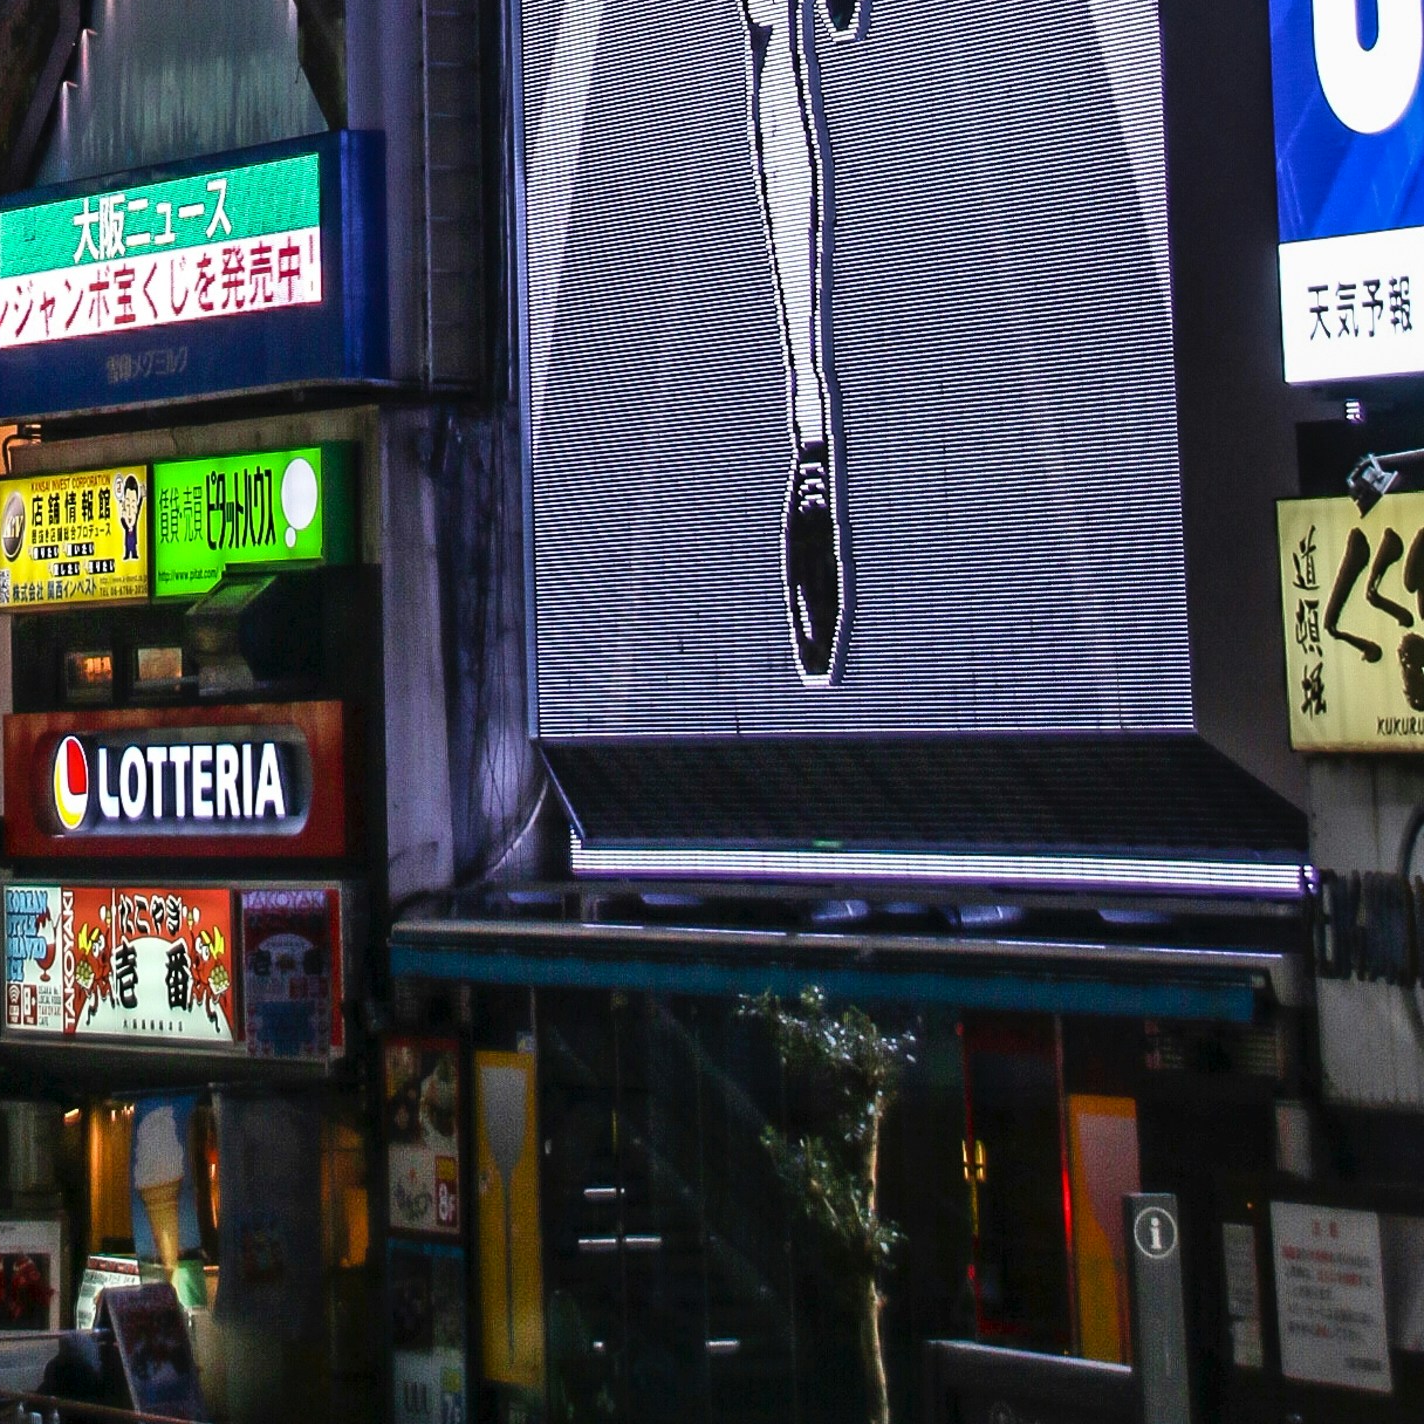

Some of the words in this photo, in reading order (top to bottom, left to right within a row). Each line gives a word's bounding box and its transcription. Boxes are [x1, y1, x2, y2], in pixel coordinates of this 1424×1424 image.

[73, 178, 232, 264] 大阪ニュース
[1307, 276, 1414, 342] 天気予報
[31, 486, 112, 527] 店舗情報館
[205, 465, 277, 551] ピタットハウス
[12, 583, 44, 603] 株式会社
[98, 742, 286, 820] LOTTERIA
[118, 893, 184, 936] たこやき
[62, 890, 76, 1030] TAKOYAKI
